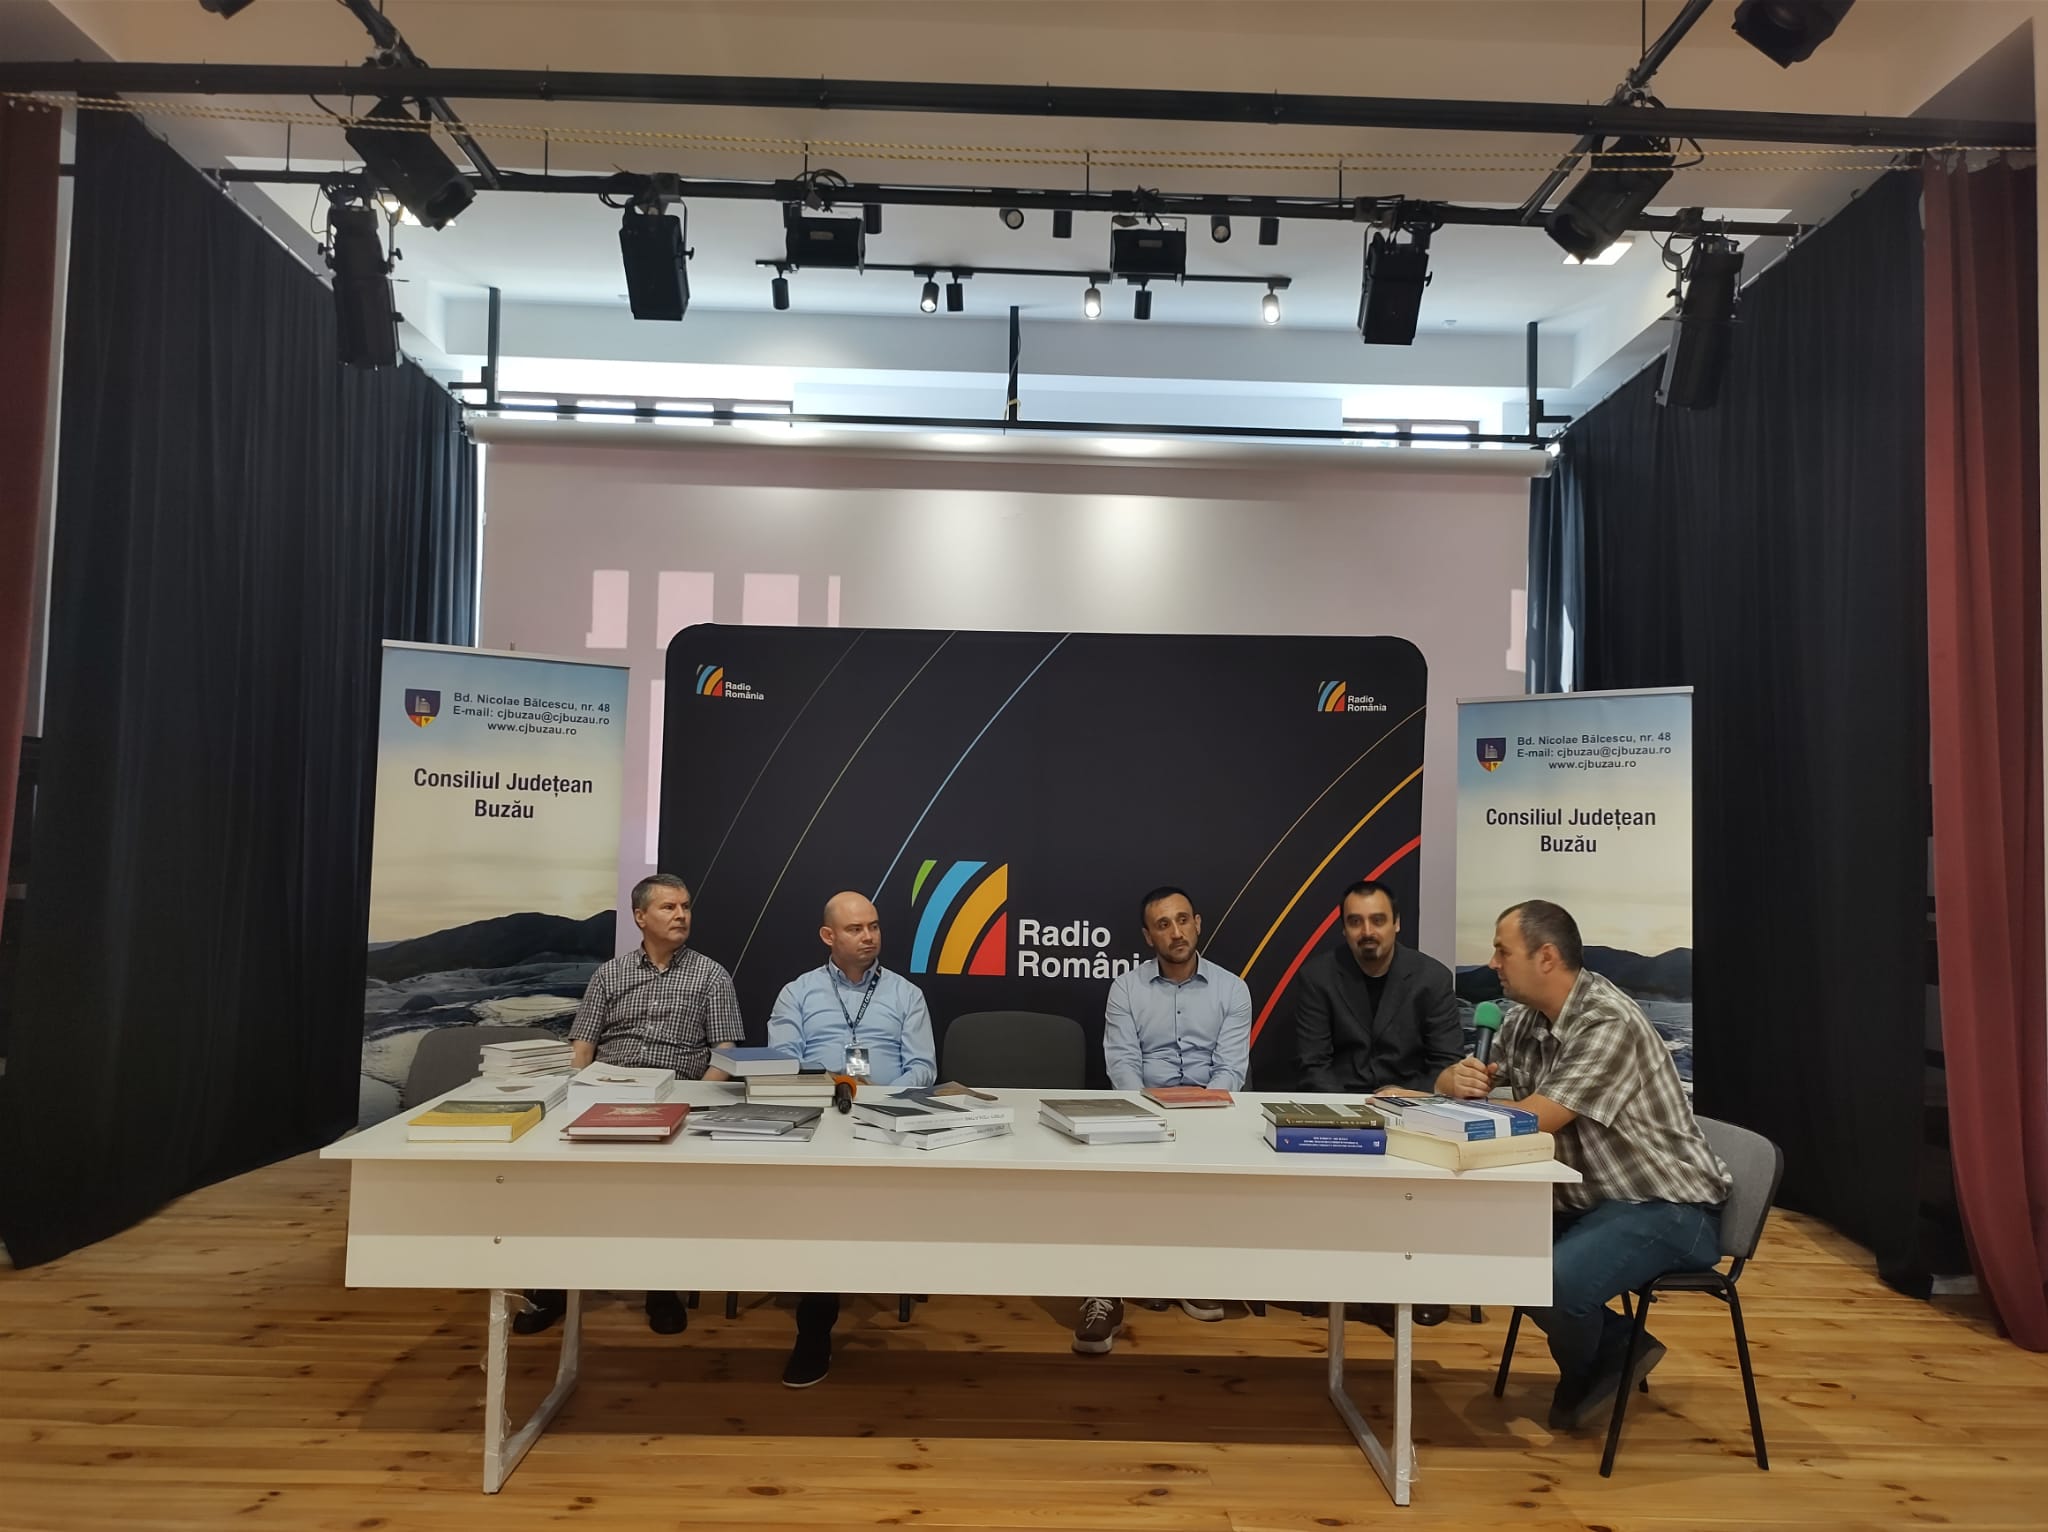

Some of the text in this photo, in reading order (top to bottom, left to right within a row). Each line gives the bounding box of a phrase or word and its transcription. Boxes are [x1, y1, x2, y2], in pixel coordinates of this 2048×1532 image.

[725, 681, 751, 691] Radio
[454, 692, 610, 713] Bd. Nicolae Bălcescu, nr. 48
[725, 689, 764, 700] România
[1347, 695, 1374, 703] Radio
[453, 705, 610, 725] E-mail: cjbuzau@cjbuzau.ro
[1347, 703, 1387, 712] România
[487, 721, 577, 735] www.cjbuzau.ro
[1517, 732, 1671, 746] Bd. Nicolae Bălcescu, nr. 48
[1517, 745, 1672, 758] E-mail: cjbuzau@cjbuzau.ro
[1548, 759, 1637, 771] www.cjbuzau.ro
[414, 768, 593, 798] Consiliul Județean
[474, 799, 534, 819] Buzău
[1486, 808, 1656, 831] Consiliul Județean
[1540, 834, 1597, 852] Buzău
[1018, 919, 1111, 948] Radio
[1018, 950, 1153, 979] Români
